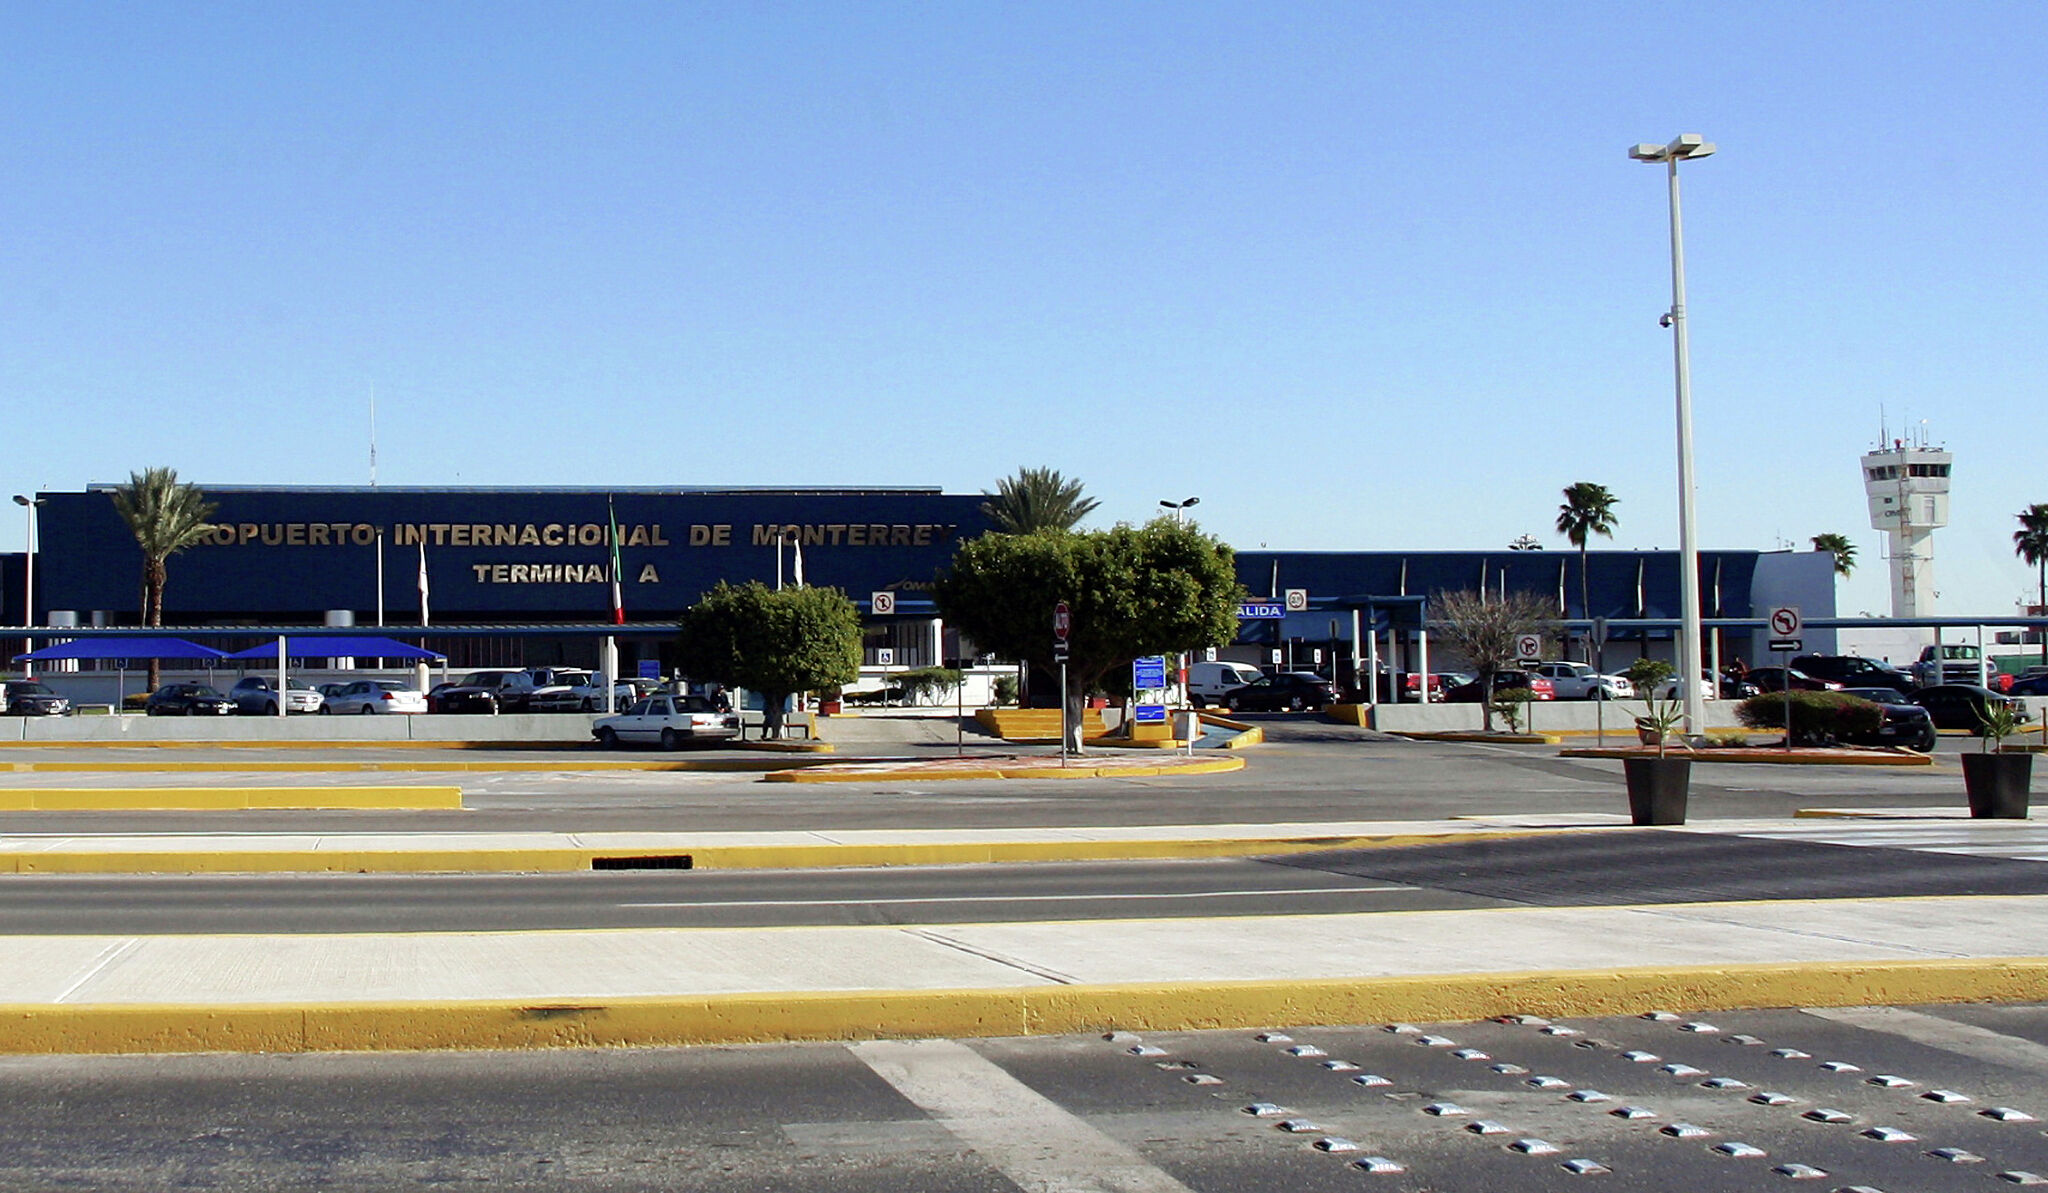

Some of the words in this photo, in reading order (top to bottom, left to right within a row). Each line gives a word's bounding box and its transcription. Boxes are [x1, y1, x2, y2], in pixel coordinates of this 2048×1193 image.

[197, 523, 375, 546] ROPUERTO
[394, 523, 669, 547] INTERNACIONAL
[689, 524, 732, 546] DE
[752, 524, 957, 546] MONTERREY
[472, 564, 609, 583] TERMINA
[638, 564, 660, 583] A
[1236, 606, 1281, 616] ALIDA
